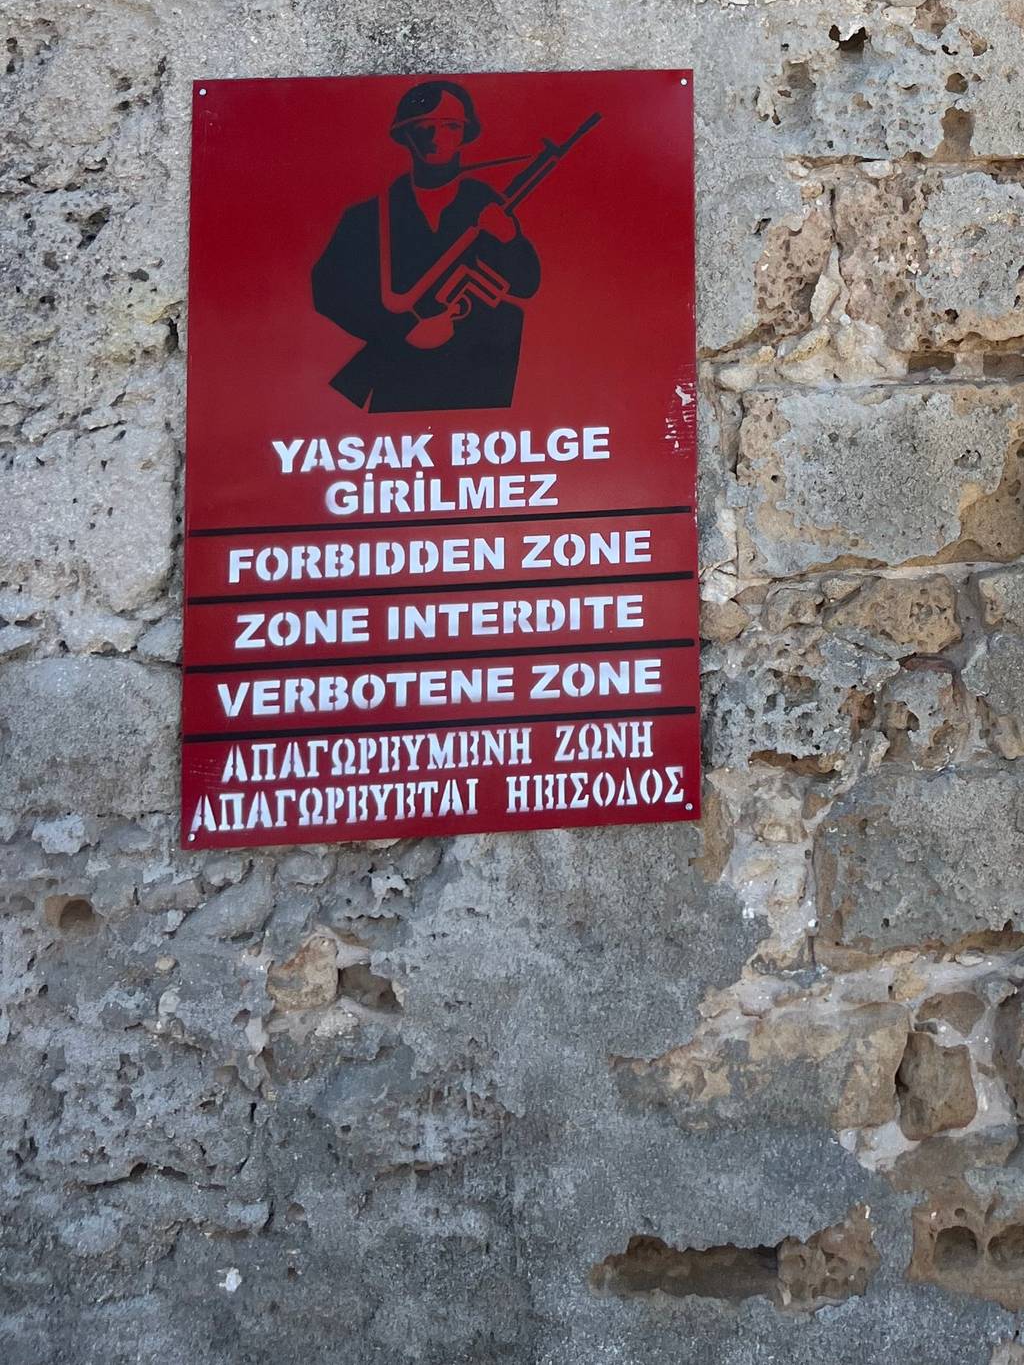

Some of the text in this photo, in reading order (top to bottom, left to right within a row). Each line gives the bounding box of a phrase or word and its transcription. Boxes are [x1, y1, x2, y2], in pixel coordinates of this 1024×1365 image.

[272, 427, 610, 473] YASAK BOLGE
[326, 471, 558, 515] GİRİLMEZ
[229, 531, 651, 583] FORBIDDEN ZONE
[235, 595, 644, 648] ZONE INTERDITE
[218, 659, 661, 716] VERBOTENE ZONE
[555, 721, 653, 761] ΖΩΝΗ
